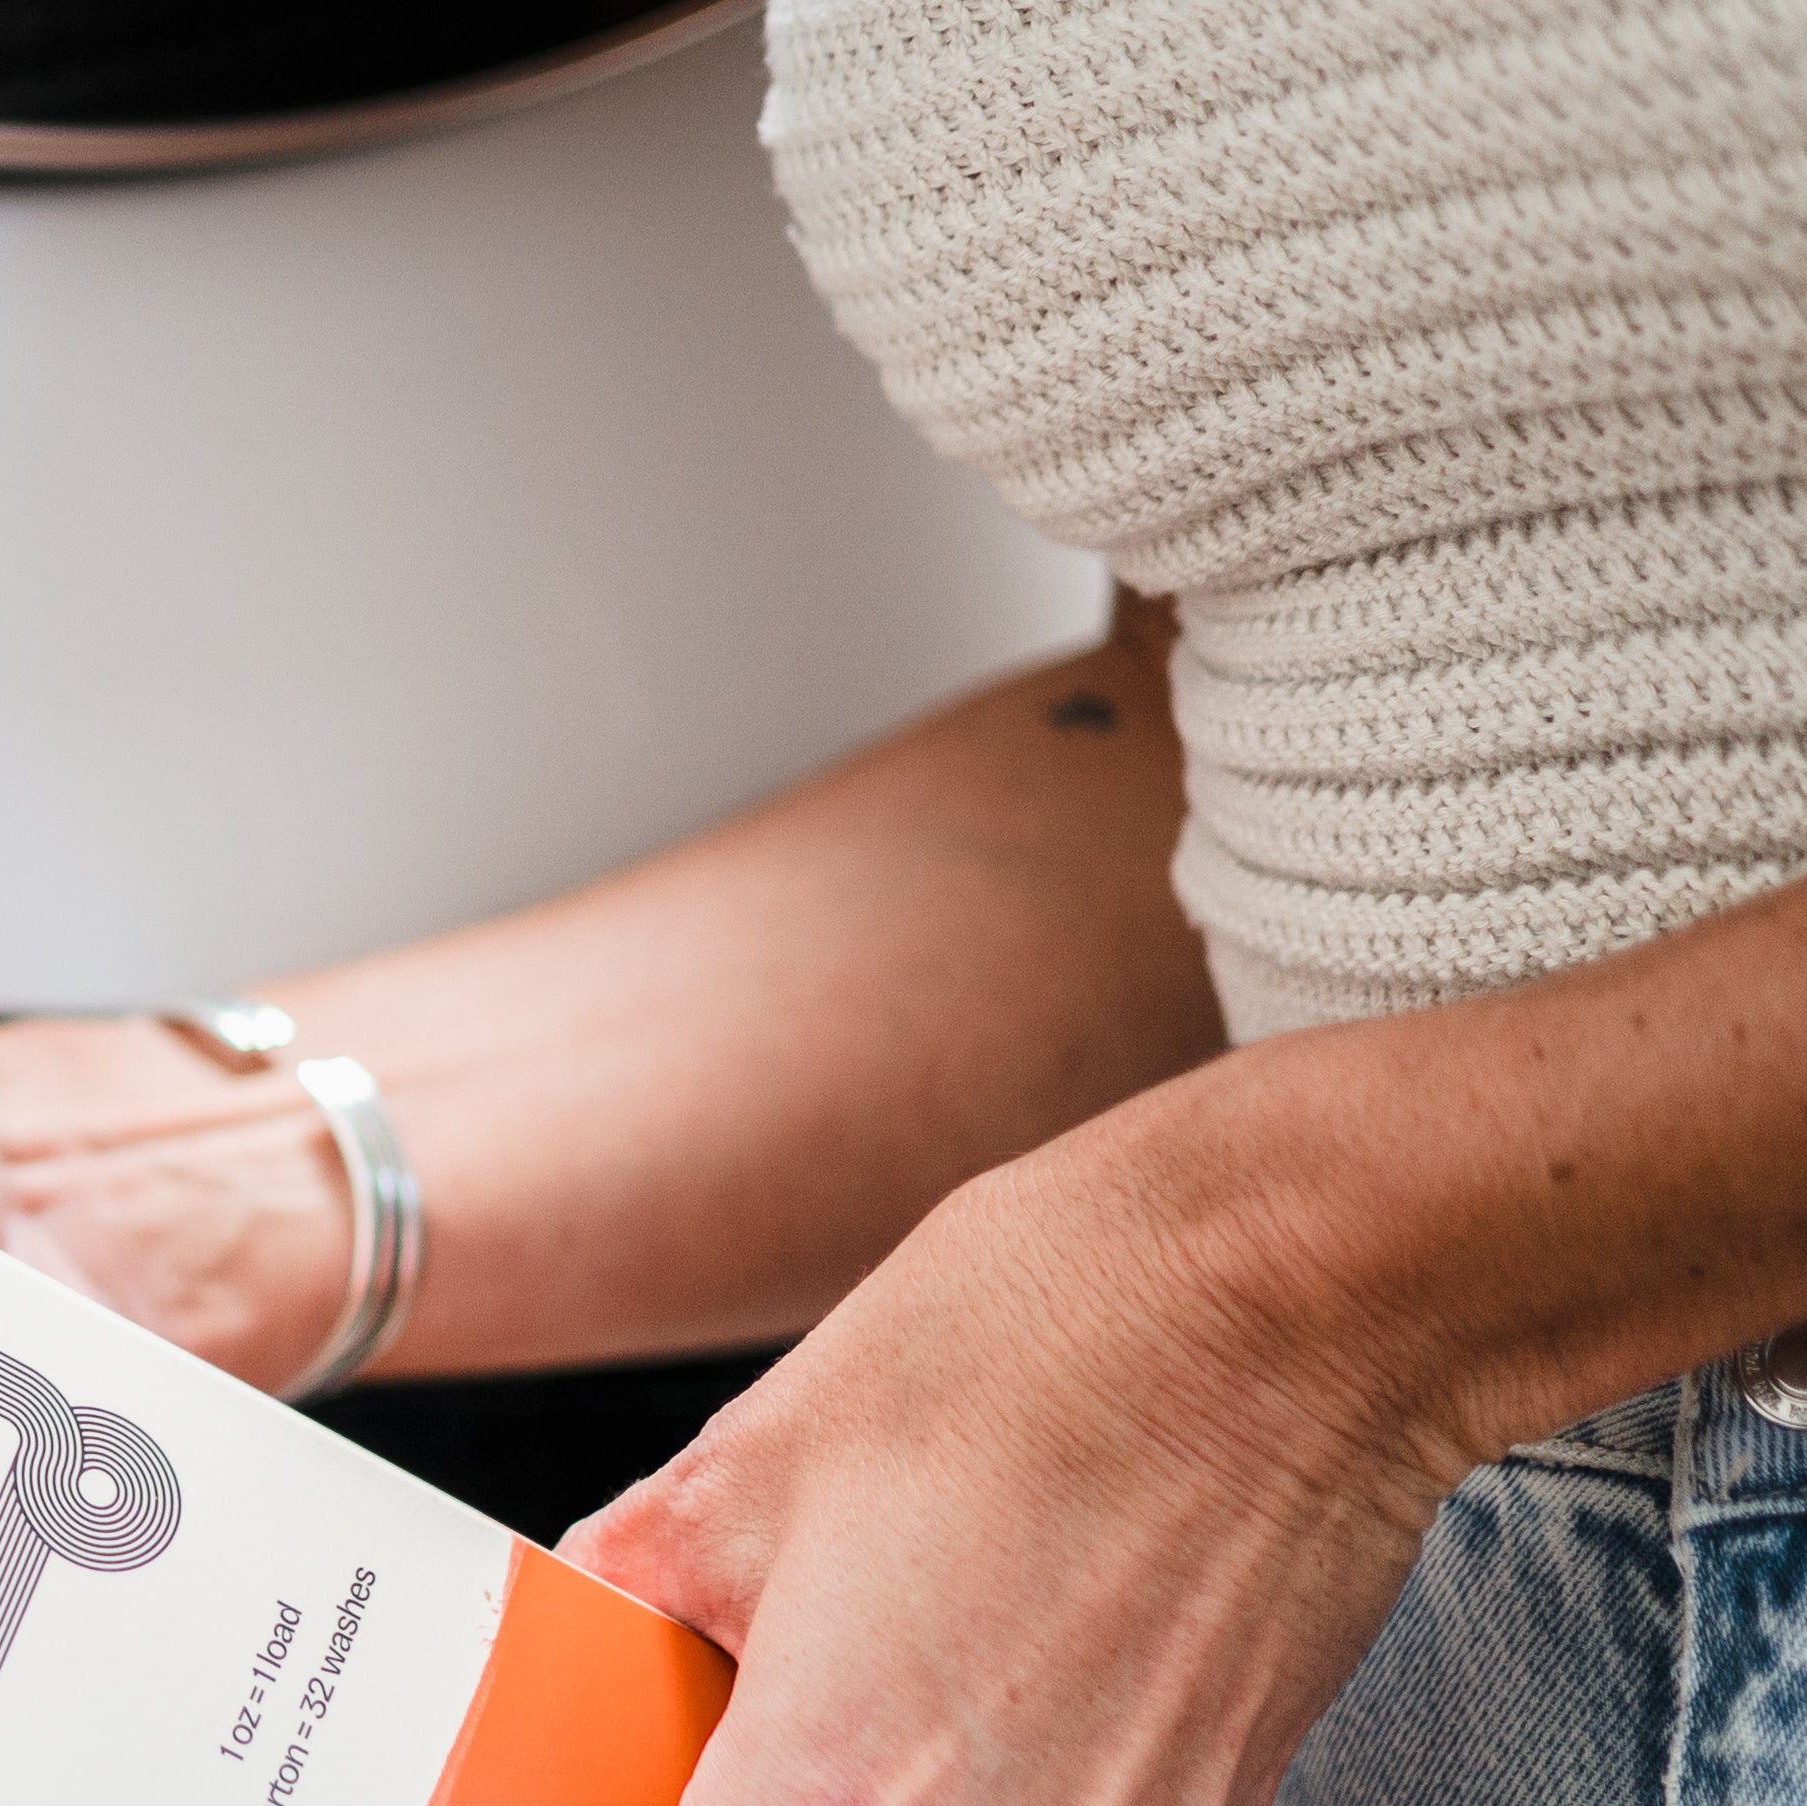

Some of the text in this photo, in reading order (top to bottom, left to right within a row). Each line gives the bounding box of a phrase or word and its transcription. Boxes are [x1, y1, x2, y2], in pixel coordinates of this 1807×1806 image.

[320, 1566, 376, 1675] washes
[220, 1600, 303, 1761] 1 oz = 1 load
[299, 1677, 335, 1719] 32
[298, 1721, 313, 1739] =
